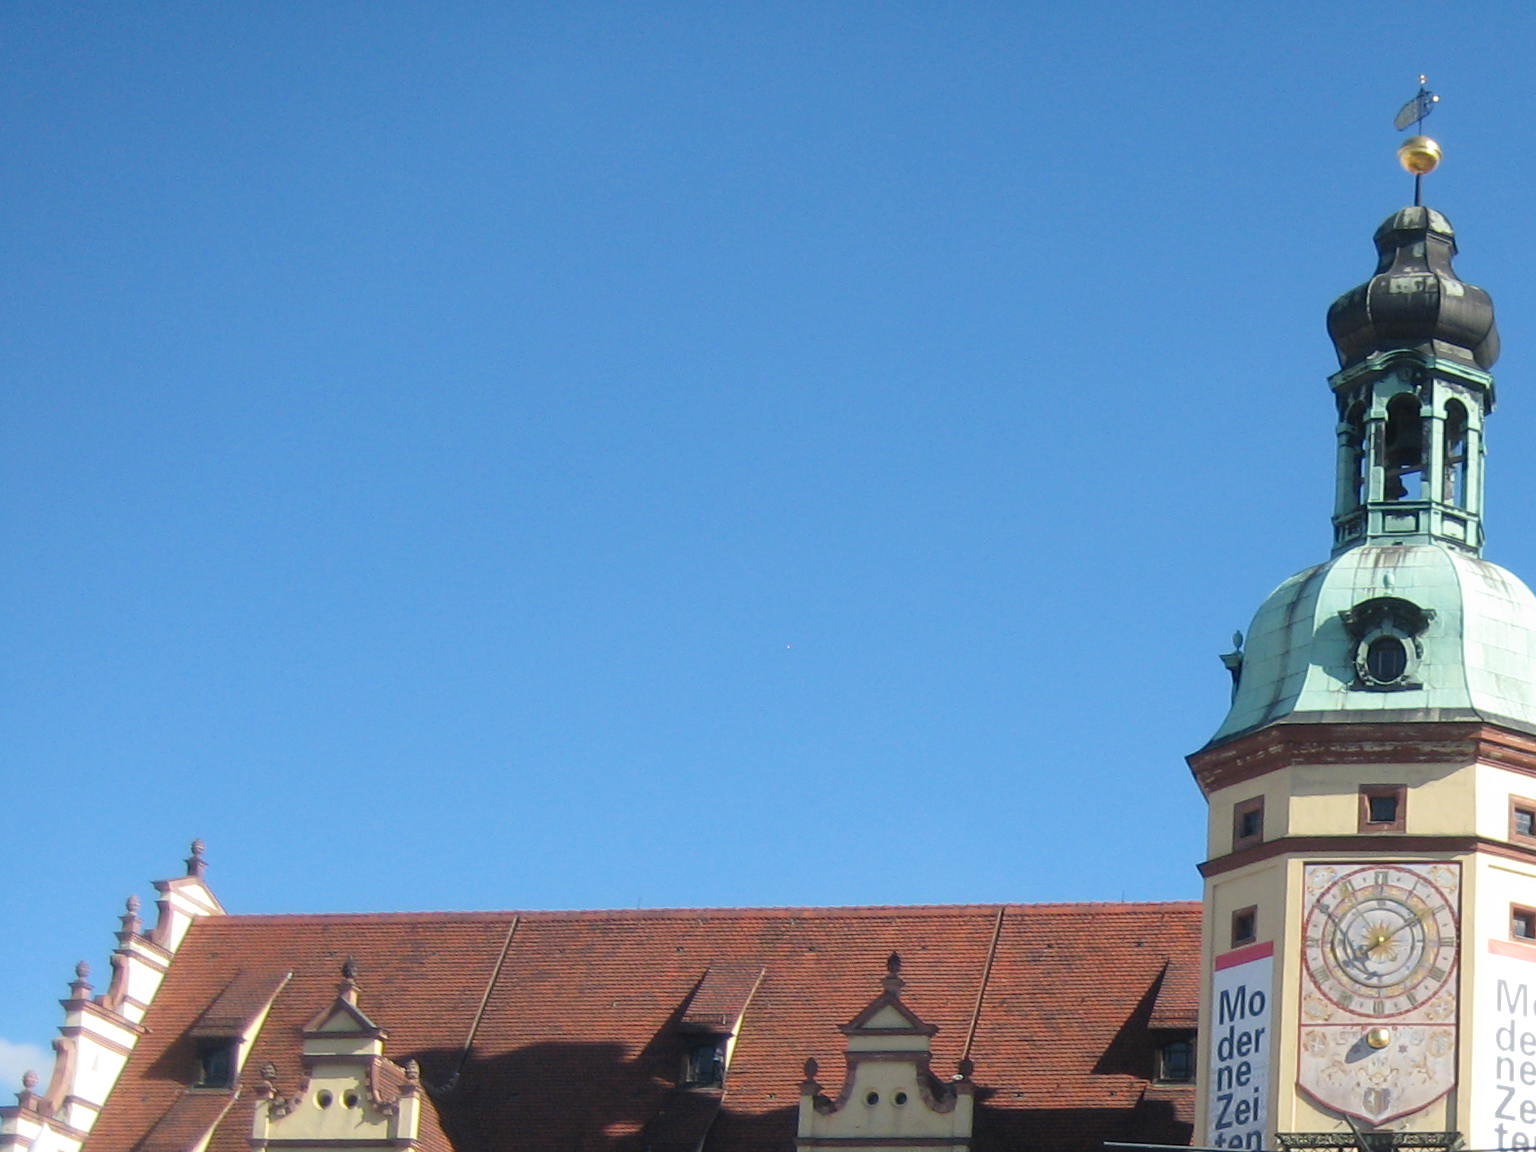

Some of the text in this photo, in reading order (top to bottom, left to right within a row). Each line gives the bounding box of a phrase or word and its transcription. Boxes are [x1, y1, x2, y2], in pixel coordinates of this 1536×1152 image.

[1218, 985, 1266, 1025] Mo
[1217, 1026, 1266, 1062] der
[1216, 1060, 1252, 1092] ne
[1214, 1087, 1260, 1130] Zei
